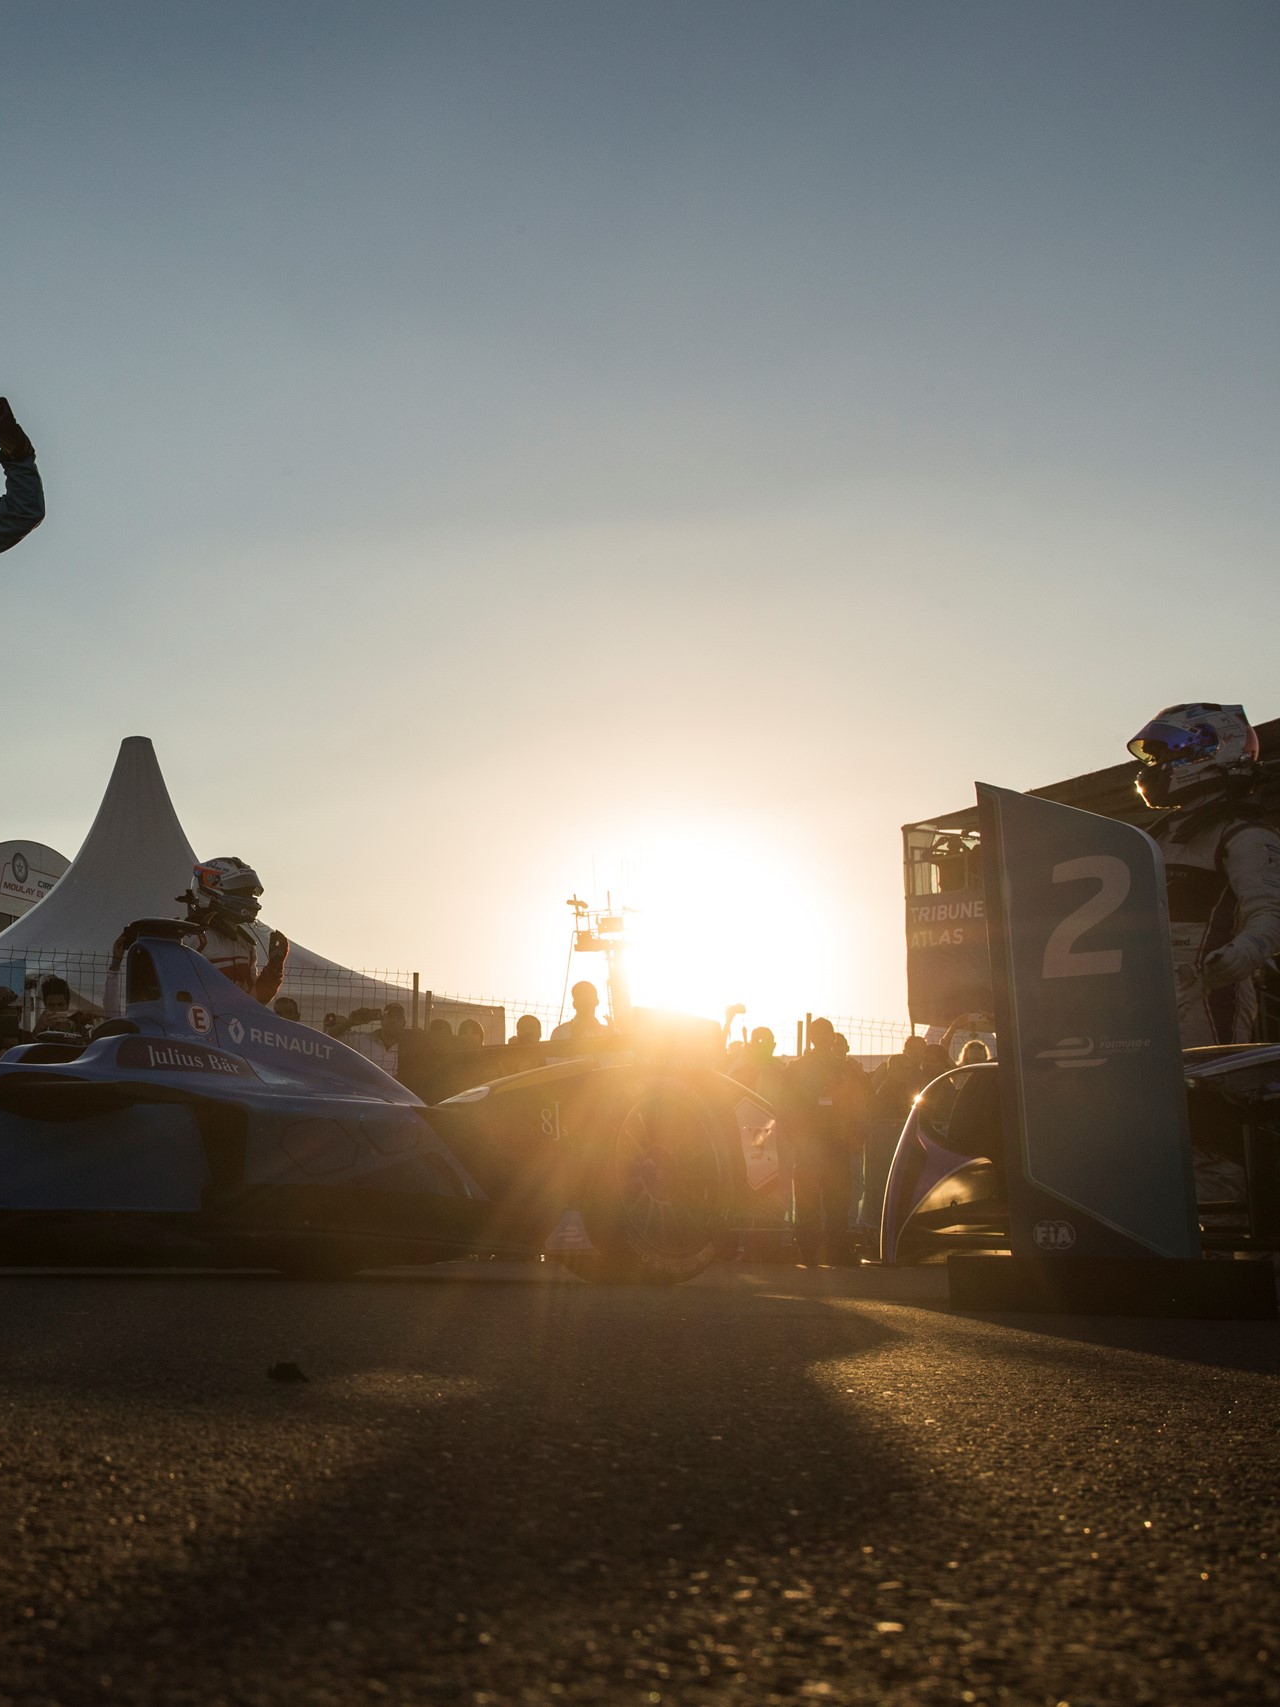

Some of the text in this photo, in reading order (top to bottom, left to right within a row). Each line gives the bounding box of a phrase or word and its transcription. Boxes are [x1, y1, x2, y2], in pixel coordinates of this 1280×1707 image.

[3, 881, 36, 896] MOULAY
[910, 900, 984, 923] TRIBUNE
[1041, 855, 1131, 979] 2
[911, 928, 964, 949] ATLAS
[192, 1008, 207, 1030] E
[250, 1027, 333, 1060] RENAULT
[147, 1045, 240, 1074] Julius Bär
